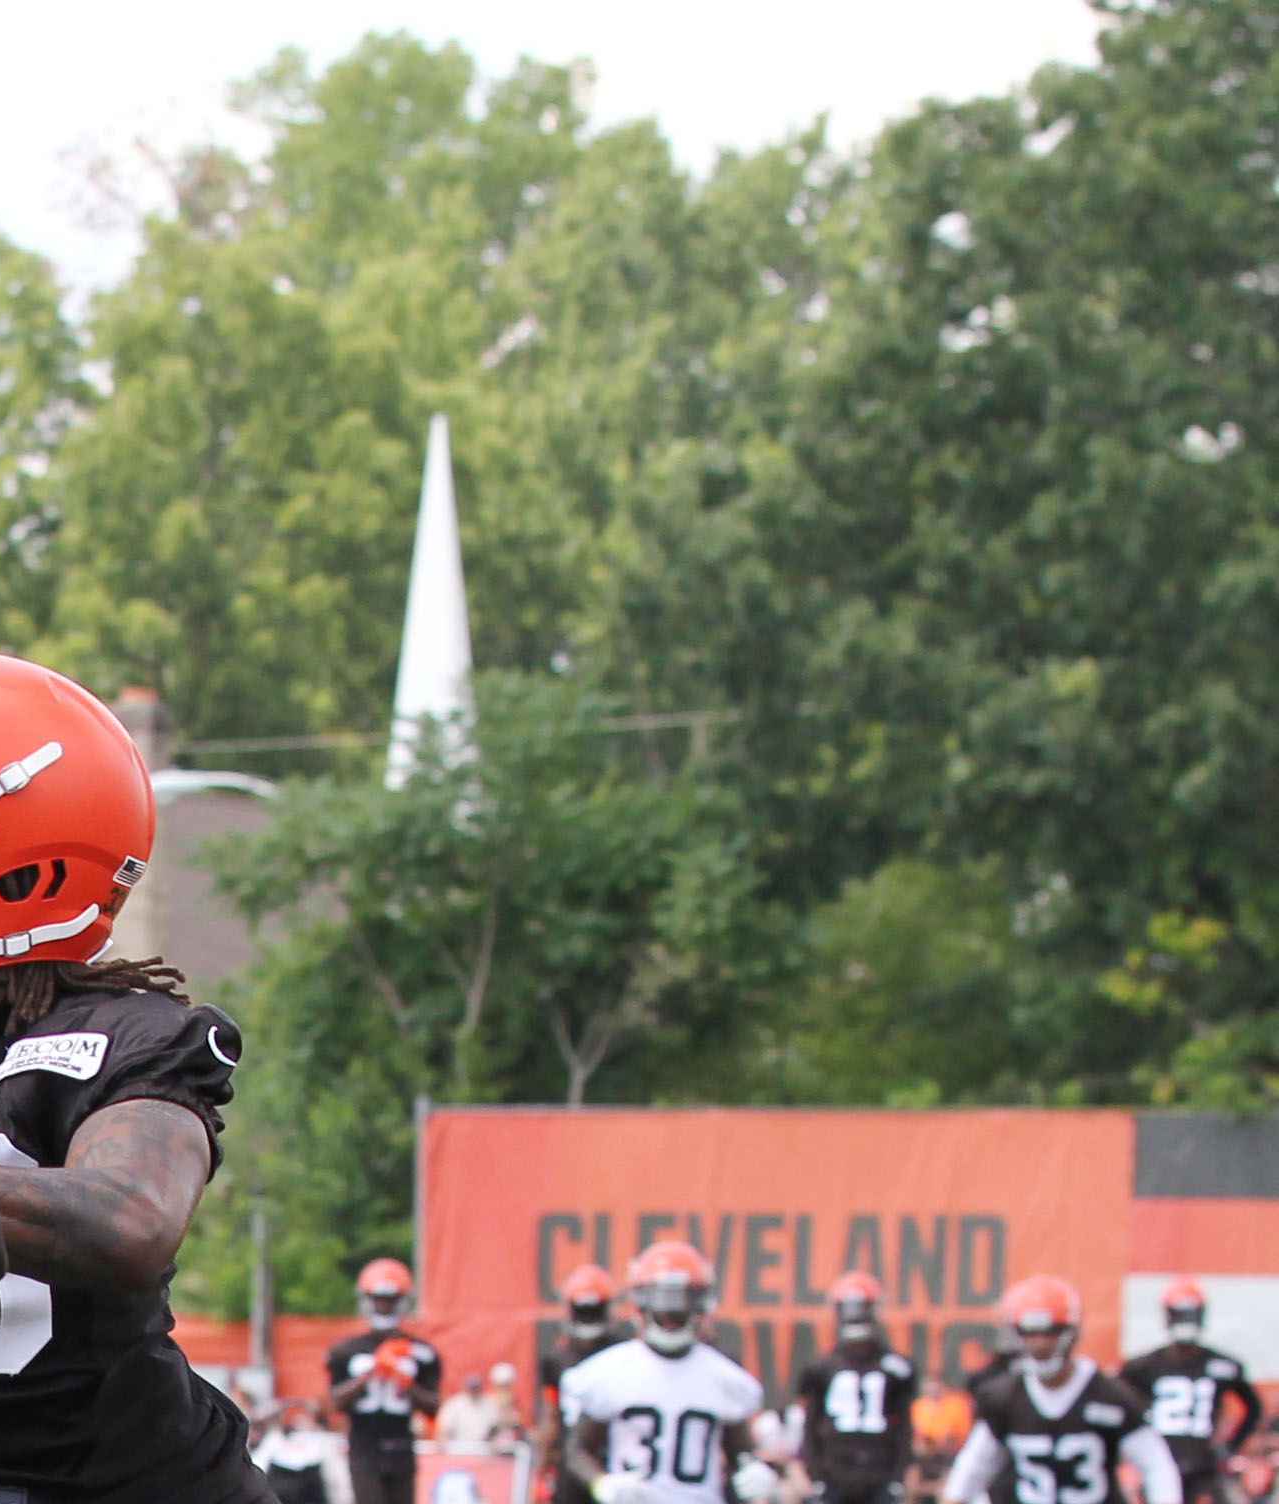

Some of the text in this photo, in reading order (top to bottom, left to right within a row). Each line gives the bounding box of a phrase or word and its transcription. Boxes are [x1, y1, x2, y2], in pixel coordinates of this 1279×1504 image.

[825, 1370, 888, 1433] 41
[1152, 1375, 1216, 1438] 21
[621, 1405, 716, 1484] 30
